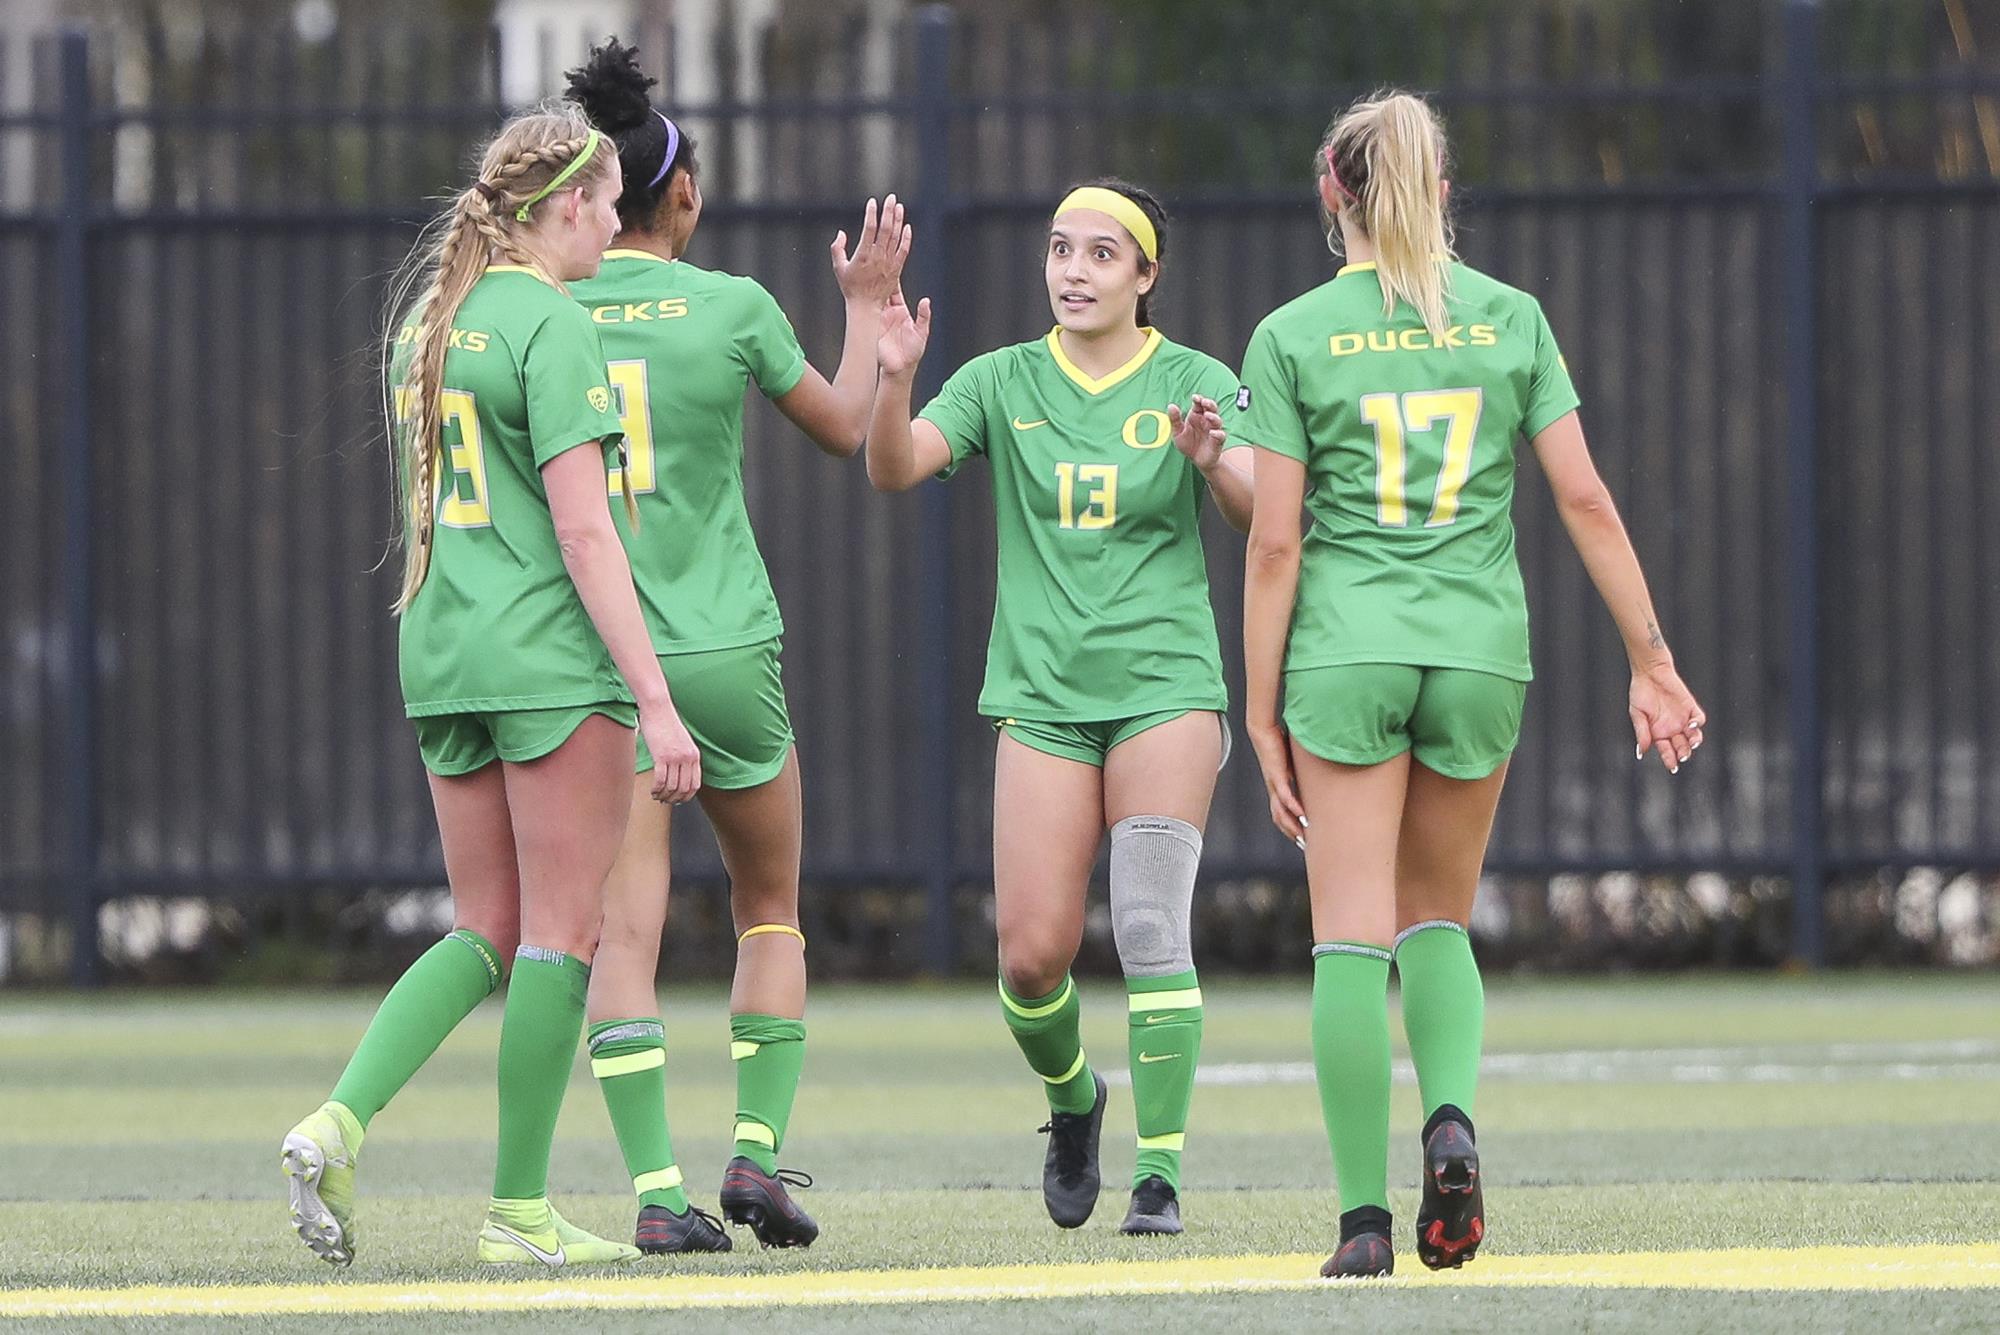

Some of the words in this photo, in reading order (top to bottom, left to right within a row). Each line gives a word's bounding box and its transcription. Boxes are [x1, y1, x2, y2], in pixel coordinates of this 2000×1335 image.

[591, 297, 688, 324] CKS
[397, 325, 490, 352] DKS
[1329, 323, 1498, 357] DUCKS
[1359, 386, 1483, 528] 17
[1054, 461, 1119, 530] 13
